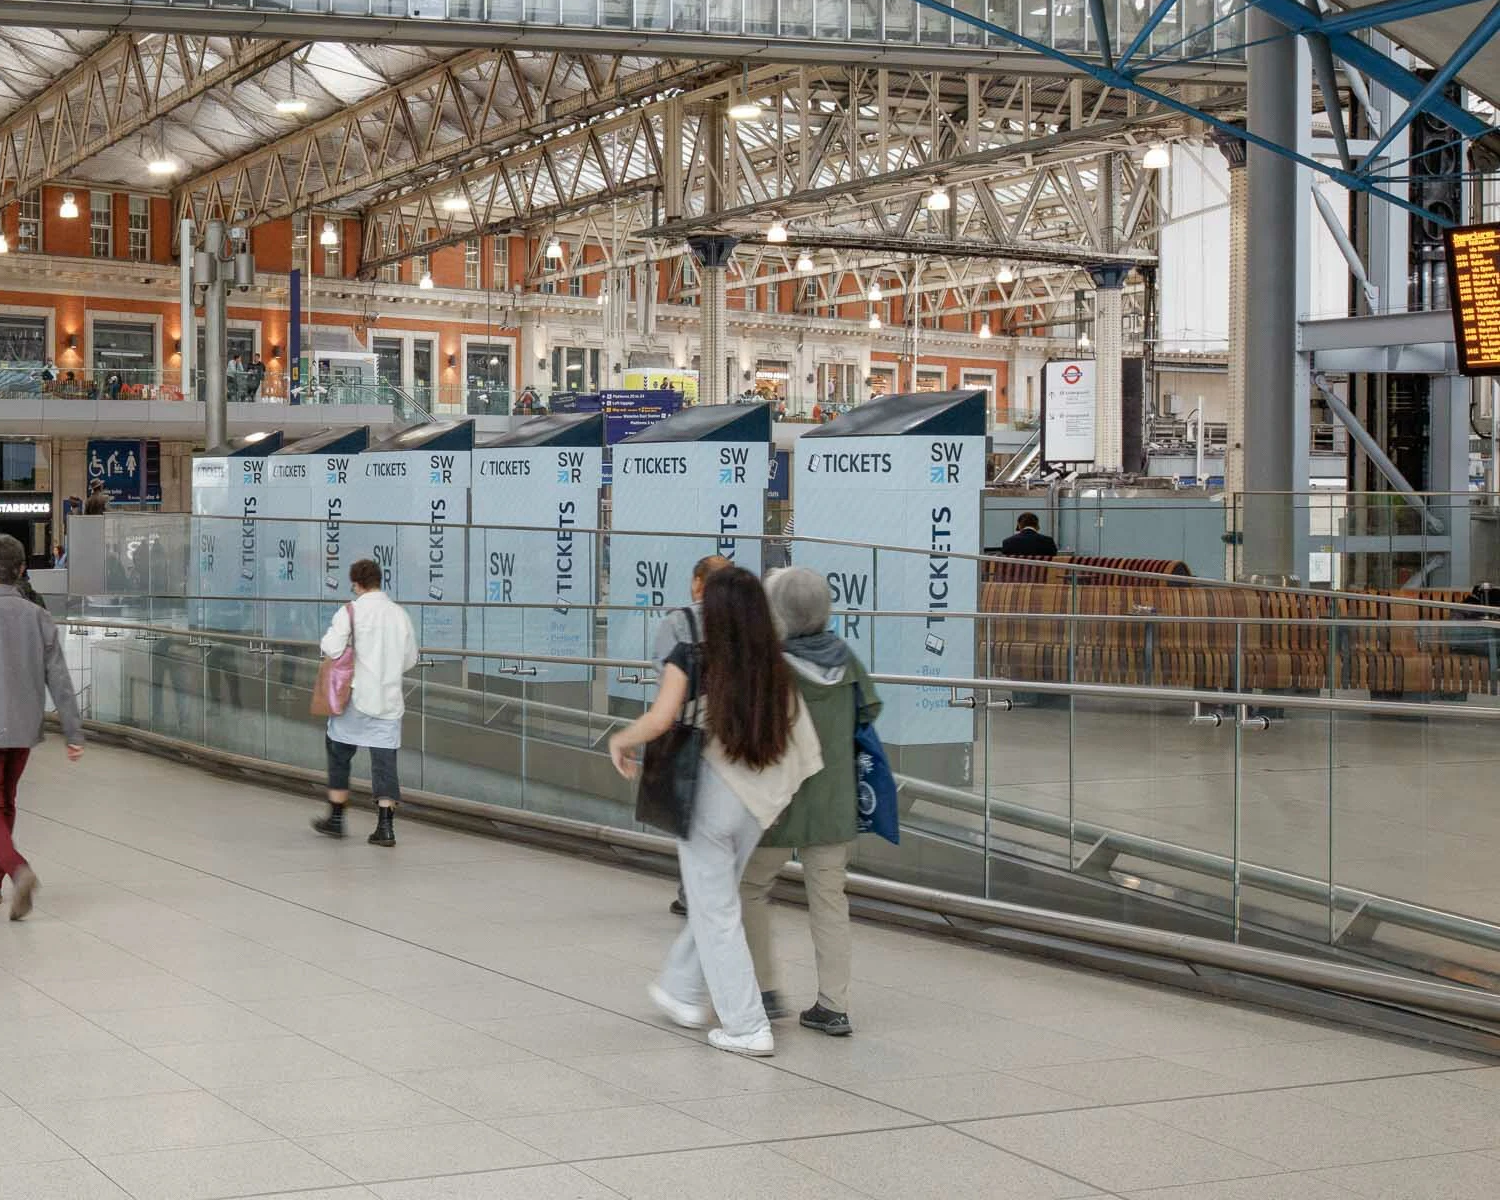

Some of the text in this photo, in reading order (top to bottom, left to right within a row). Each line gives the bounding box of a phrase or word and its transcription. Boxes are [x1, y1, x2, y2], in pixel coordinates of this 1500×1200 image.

[558, 452, 584, 467] SW
[720, 448, 748, 465] SW
[931, 442, 963, 462] SW
[244, 461, 264, 472] SW
[327, 458, 349, 471] SW
[373, 462, 406, 477] TICKETS
[430, 455, 454, 469] SW
[490, 460, 531, 475] TICKETS
[634, 457, 687, 474] TICKETS
[823, 453, 892, 473] TICKETS
[326, 498, 342, 573] TICKETS
[429, 499, 446, 583] TICKETS
[556, 501, 575, 594] TICKETS
[490, 552, 515, 576] SW
[926, 506, 952, 629] TICKETS
[636, 560, 668, 588] SW
